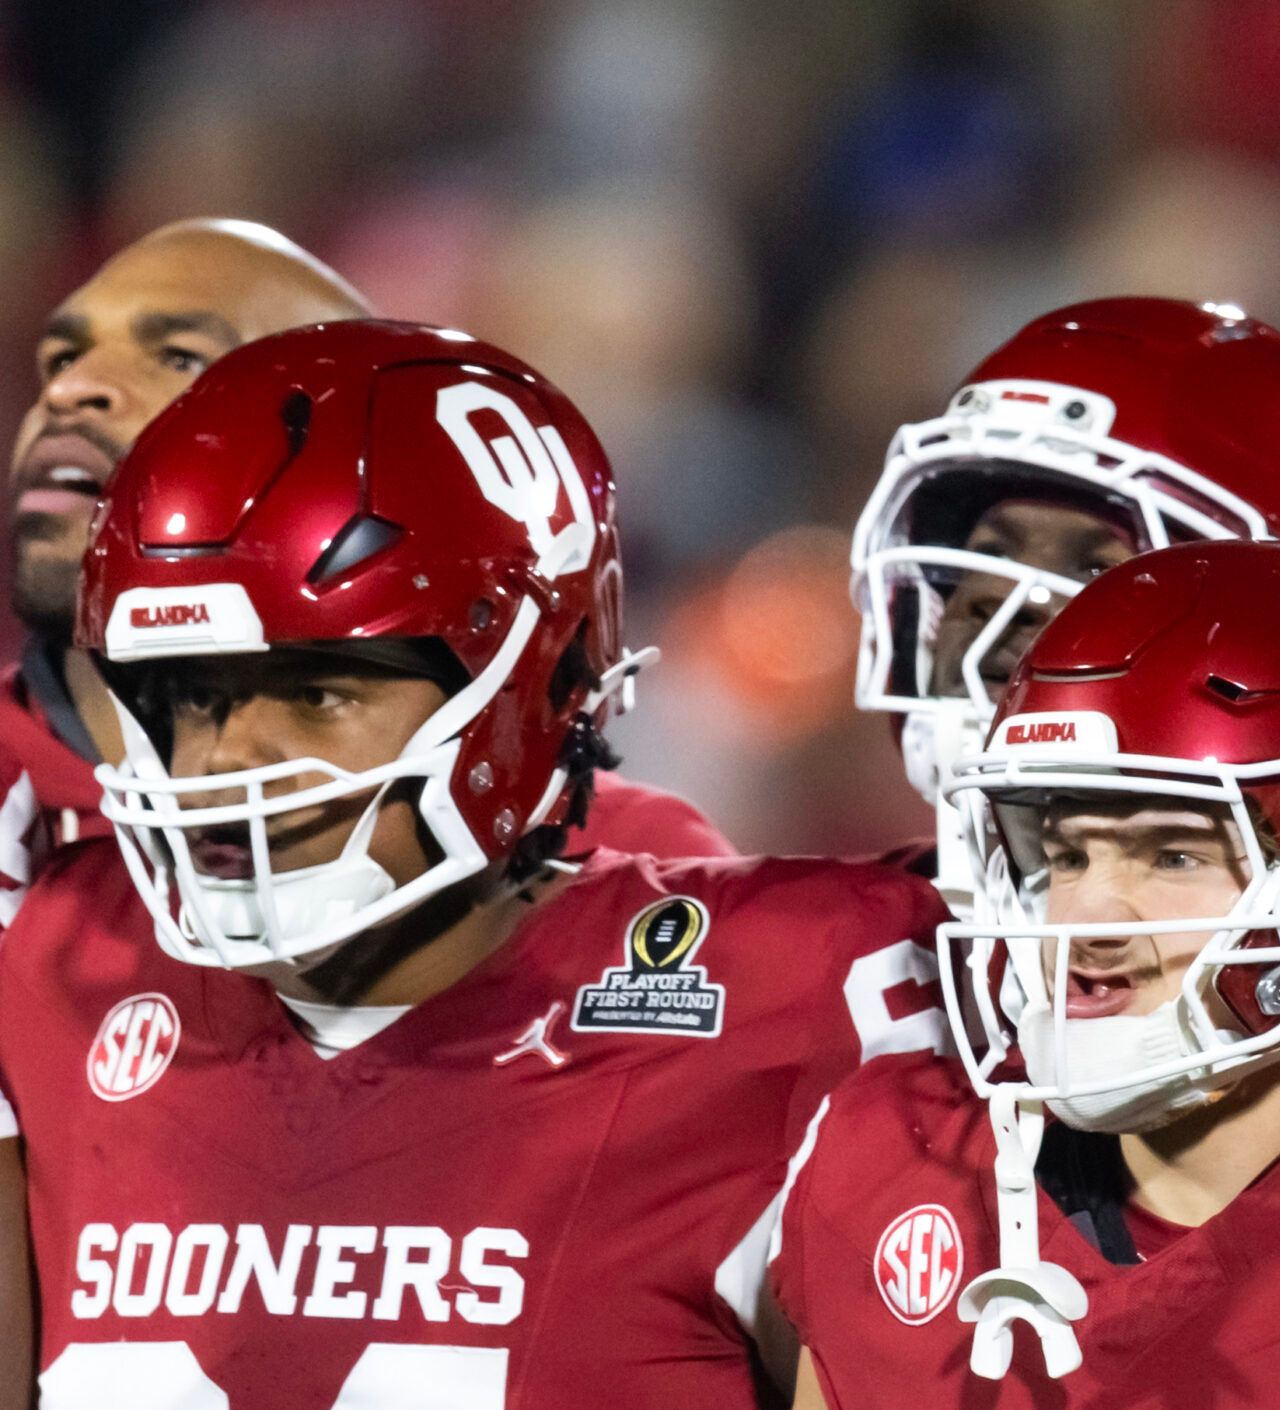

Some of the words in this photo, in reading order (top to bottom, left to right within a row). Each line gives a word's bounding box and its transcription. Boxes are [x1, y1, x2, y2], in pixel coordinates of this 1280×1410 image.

[436, 381, 597, 575] OU
[584, 991, 644, 1007] FIRST
[645, 991, 716, 1010] ROUND
[609, 974, 696, 990] PLAYOFF
[94, 1001, 174, 1094] SEC
[72, 1222, 528, 1324] SOONERS
[883, 1213, 954, 1315] SEC
